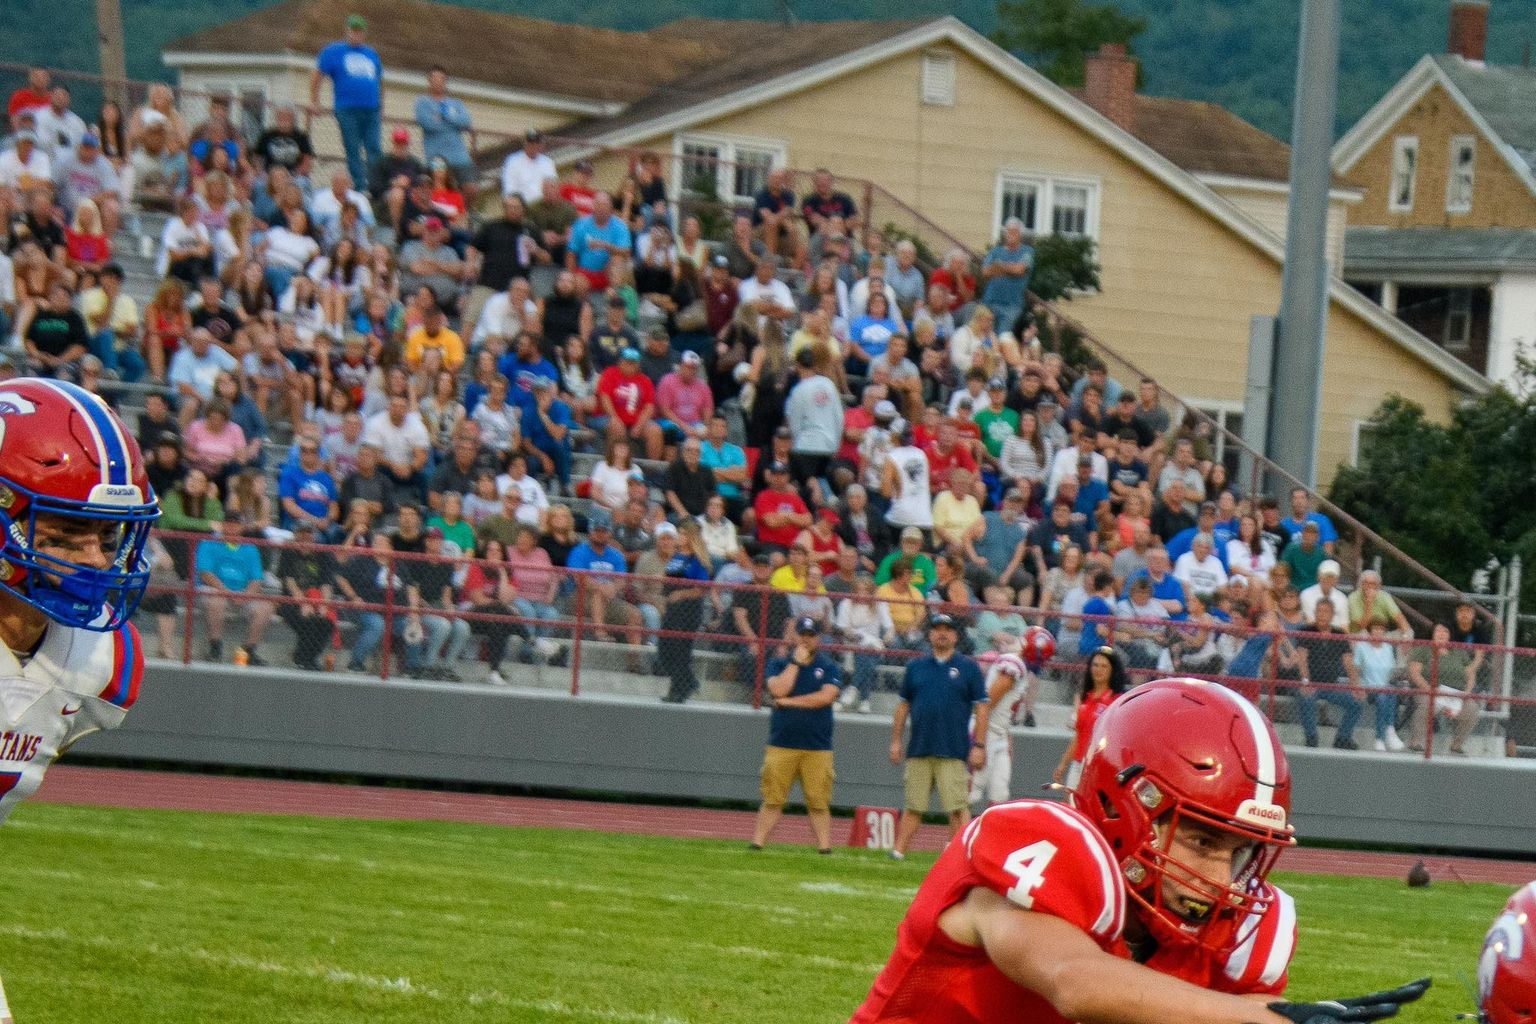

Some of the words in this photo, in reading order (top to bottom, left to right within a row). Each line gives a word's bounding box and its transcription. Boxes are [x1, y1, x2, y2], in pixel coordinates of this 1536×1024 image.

[0, 730, 42, 762] TANS
[867, 811, 895, 849] 30
[1002, 840, 1058, 909] 4
